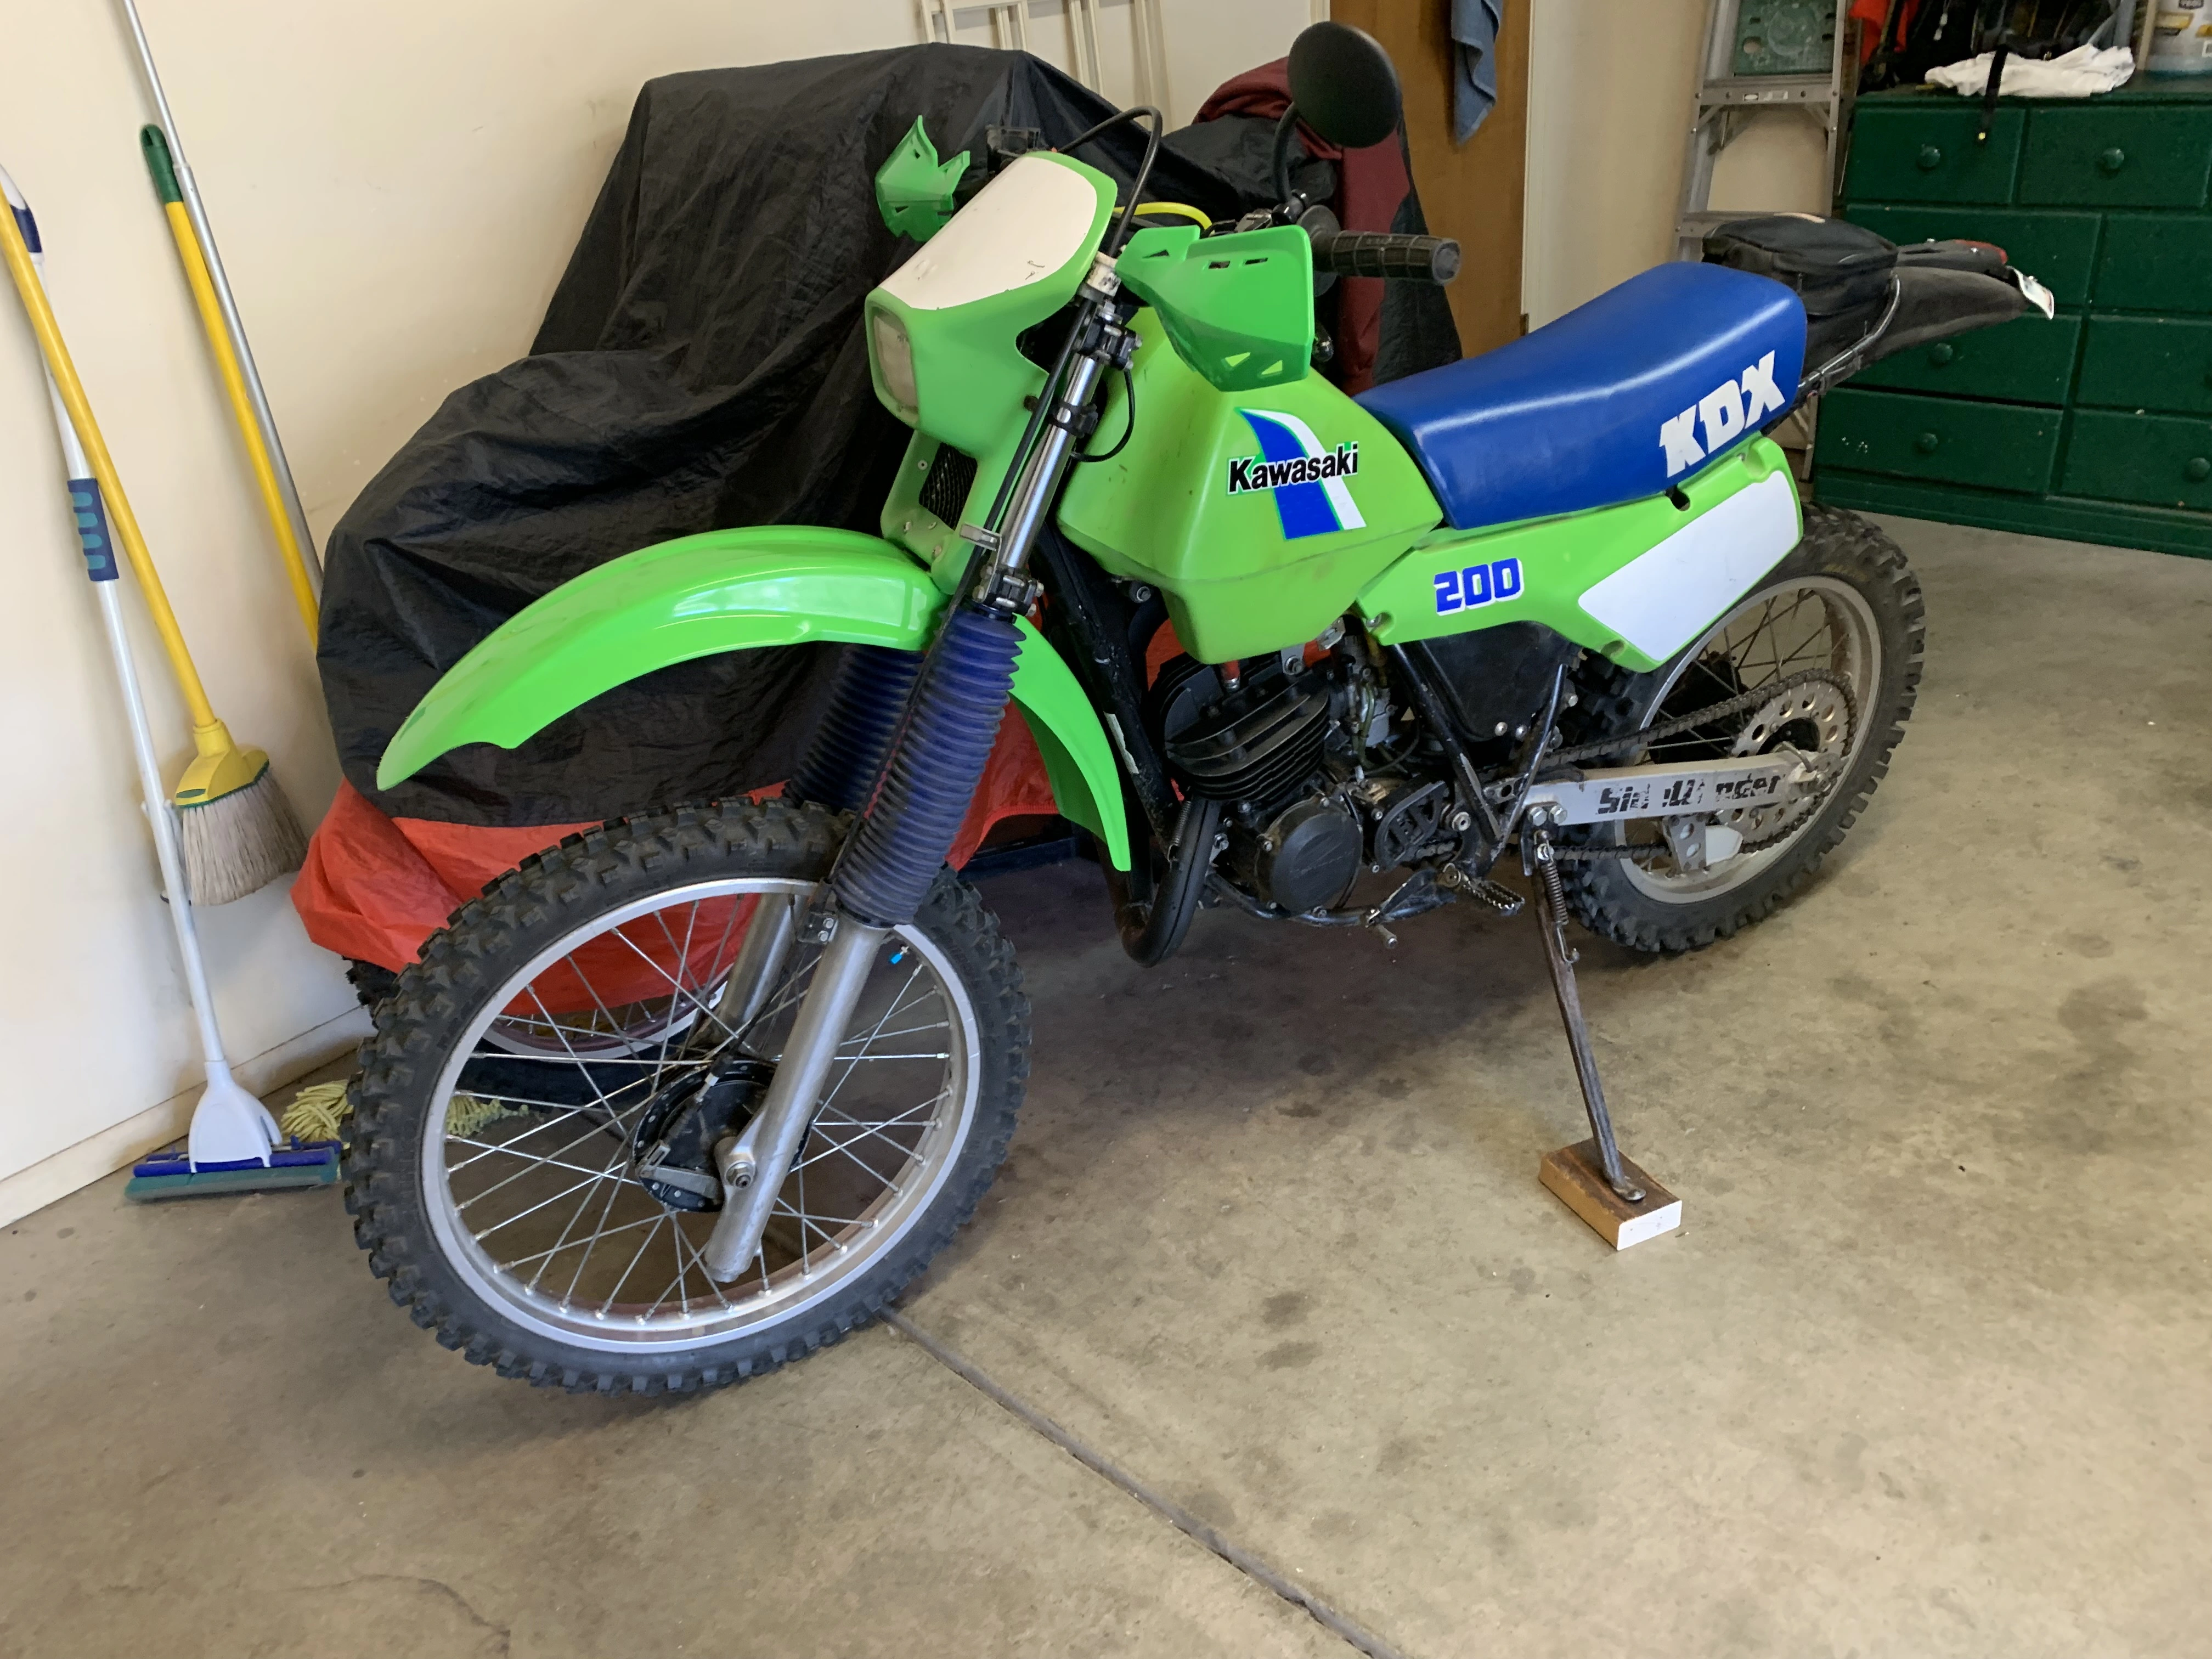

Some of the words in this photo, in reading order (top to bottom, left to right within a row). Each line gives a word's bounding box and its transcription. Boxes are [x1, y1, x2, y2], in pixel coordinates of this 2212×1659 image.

[1659, 349, 1786, 478] KDX
[1228, 442, 1358, 494] Kawasaki
[1433, 557, 1524, 614] 200
